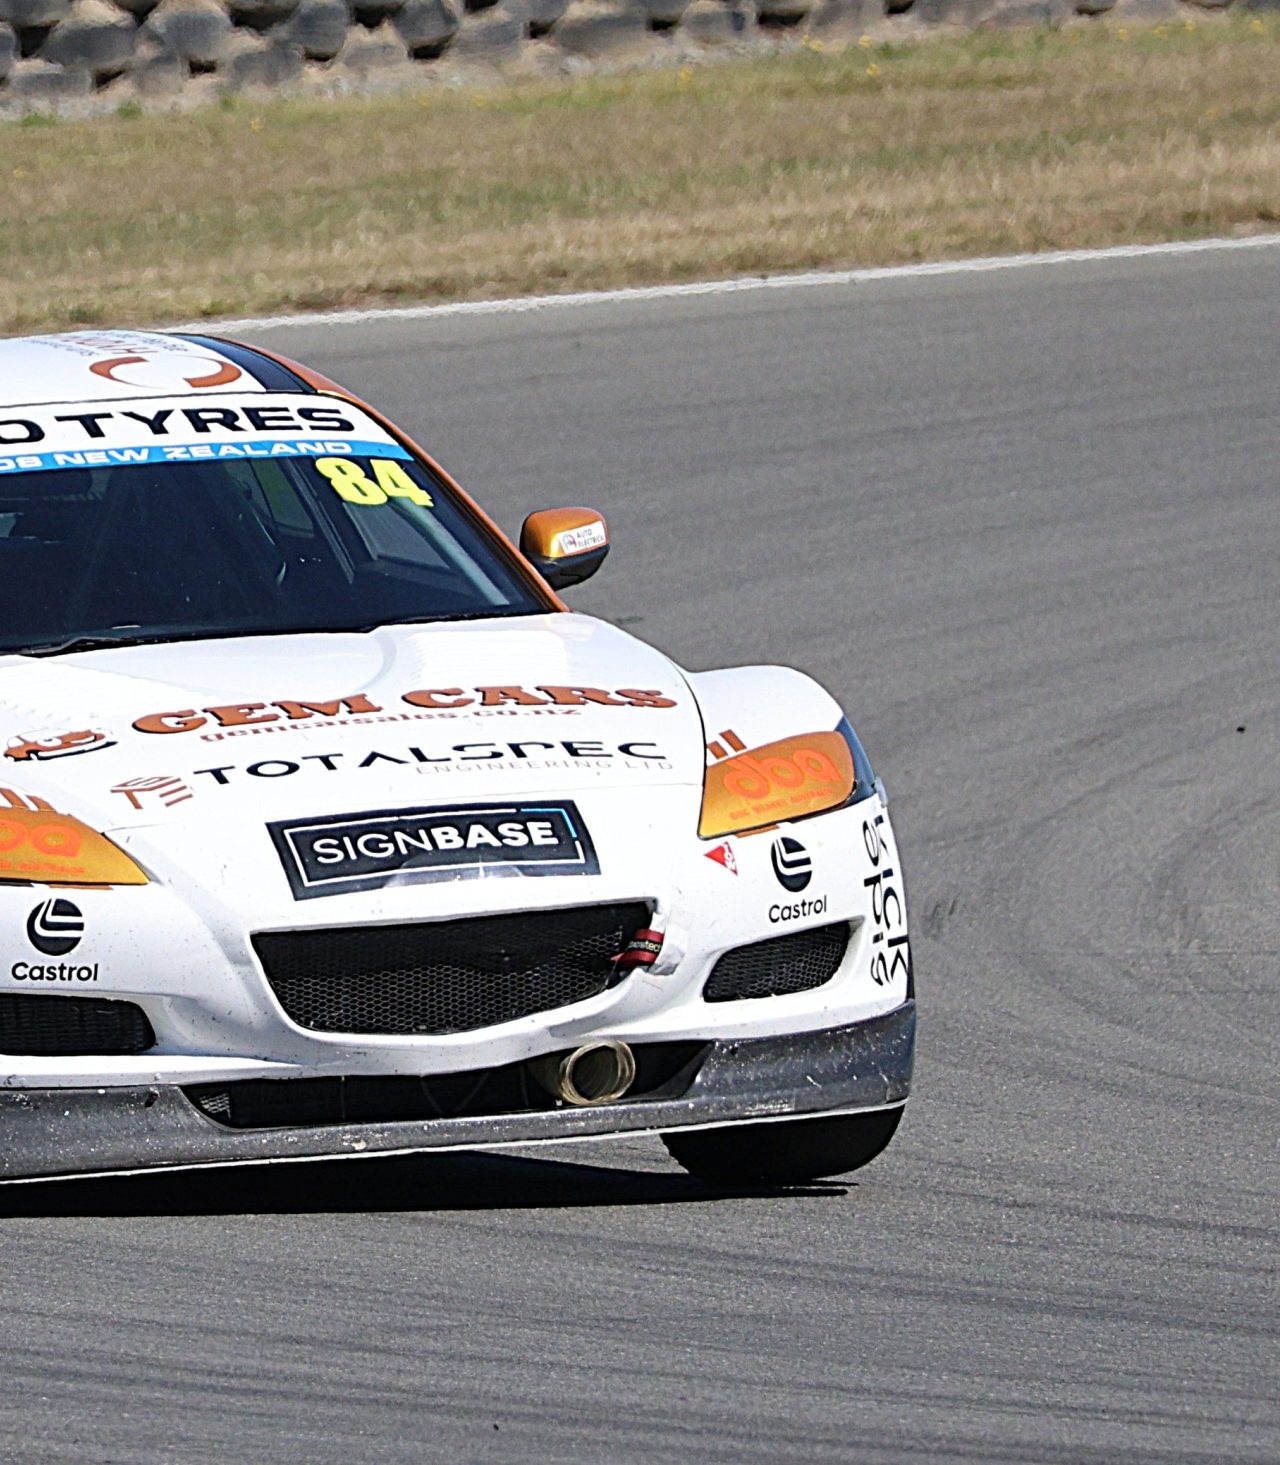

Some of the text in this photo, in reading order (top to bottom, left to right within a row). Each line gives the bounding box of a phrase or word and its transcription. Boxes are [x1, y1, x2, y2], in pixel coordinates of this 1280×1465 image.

[55, 407, 356, 438] TYRES
[54, 449, 150, 466] NEW
[162, 441, 353, 460] ZEALAND
[315, 457, 434, 508] 84
[131, 685, 677, 735] GEM CARS
[414, 758, 674, 775] ENGINEERING LTD
[312, 819, 560, 866] SIGNBASE
[768, 894, 827, 924] Castrol
[11, 961, 99, 982] Castrol
